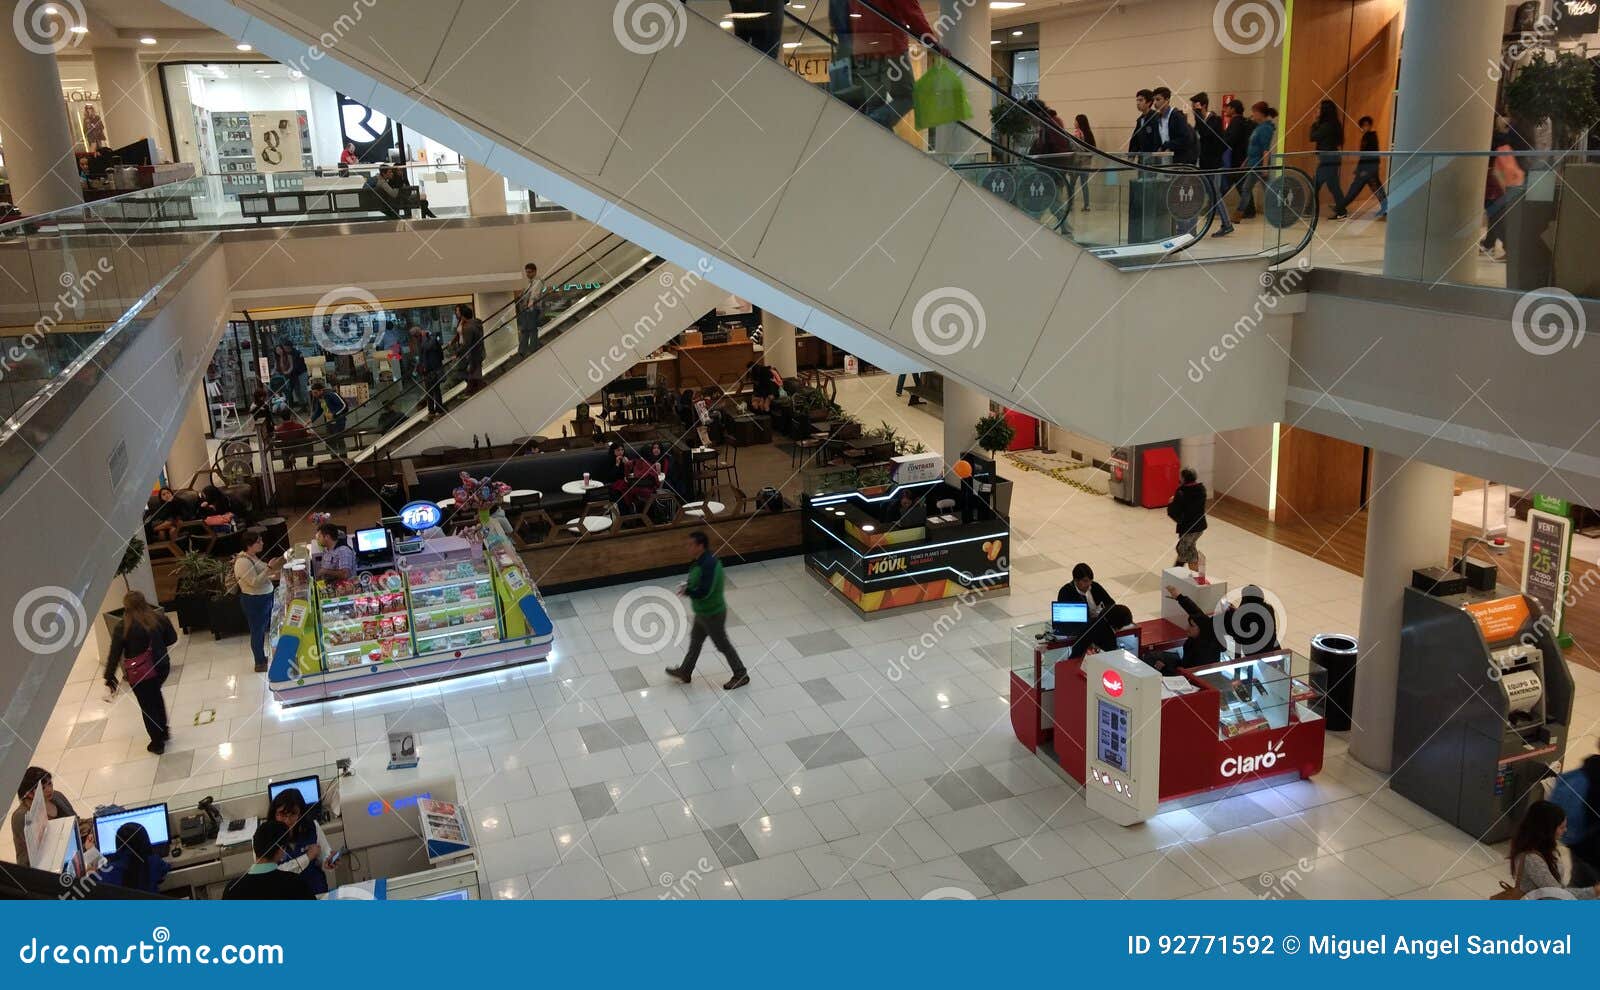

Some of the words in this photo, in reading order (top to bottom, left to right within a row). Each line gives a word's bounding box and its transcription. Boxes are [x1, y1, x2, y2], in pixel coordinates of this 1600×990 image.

[402, 505, 435, 525] fini
[868, 557, 907, 576] MÓVIL
[1220, 750, 1278, 777] Claro
